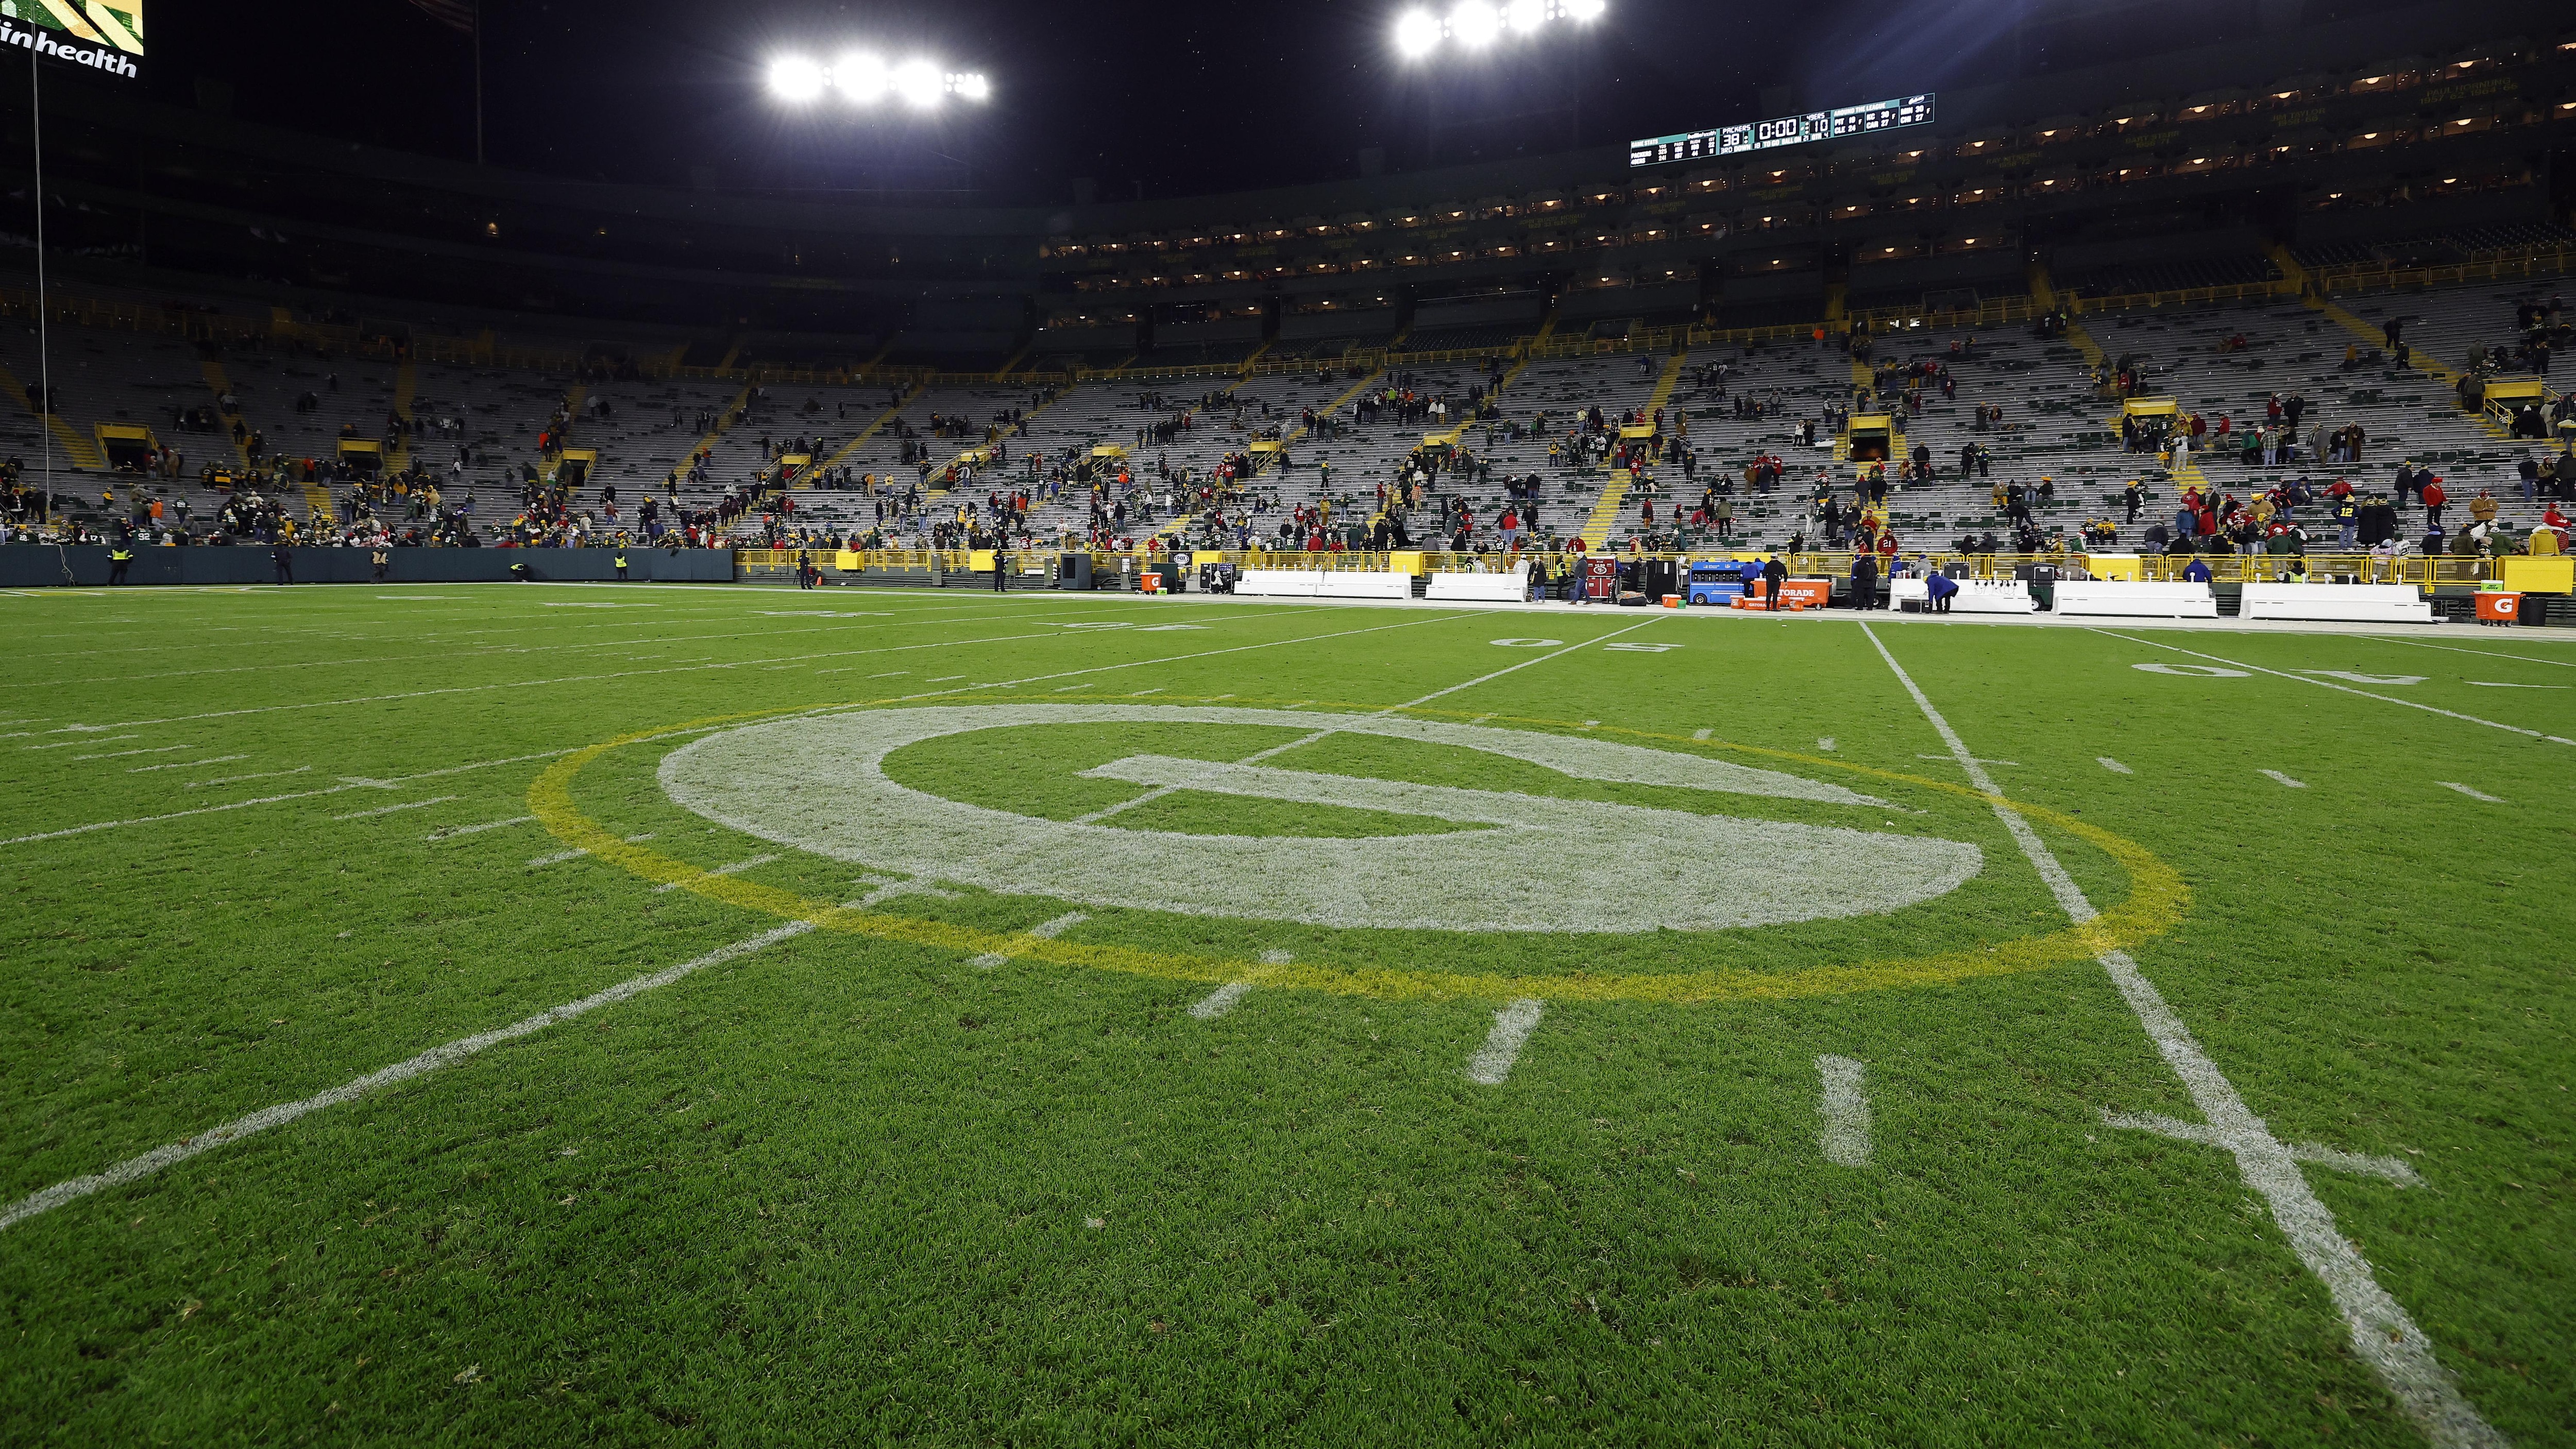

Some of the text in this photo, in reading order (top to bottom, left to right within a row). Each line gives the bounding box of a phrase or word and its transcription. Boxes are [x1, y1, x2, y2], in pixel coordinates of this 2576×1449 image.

[1834, 108, 1855, 117] AROUND
[1866, 103, 1886, 111] LEAGUE
[1900, 107, 1913, 115] MIN
[1915, 105, 1924, 113] 30
[1806, 112, 1825, 121] 49ERS
[1866, 113, 1875, 121] KC
[1900, 113, 1924, 124] CHI 27
[1815, 119, 1828, 132] 10
[1835, 118, 1844, 126] PIT
[1722, 124, 1751, 134] PACKERS
[1759, 118, 1797, 140] 0:00
[1848, 124, 1856, 132] 24
[1723, 133, 1740, 147] 38
[1734, 144, 1751, 152] DOWN
[1631, 150, 1652, 159] PACKERS
[2340, 507, 2353, 517] 12
[1883, 539, 1891, 548] 21
[1151, 577, 1159, 587] G
[2495, 598, 2513, 613] G
